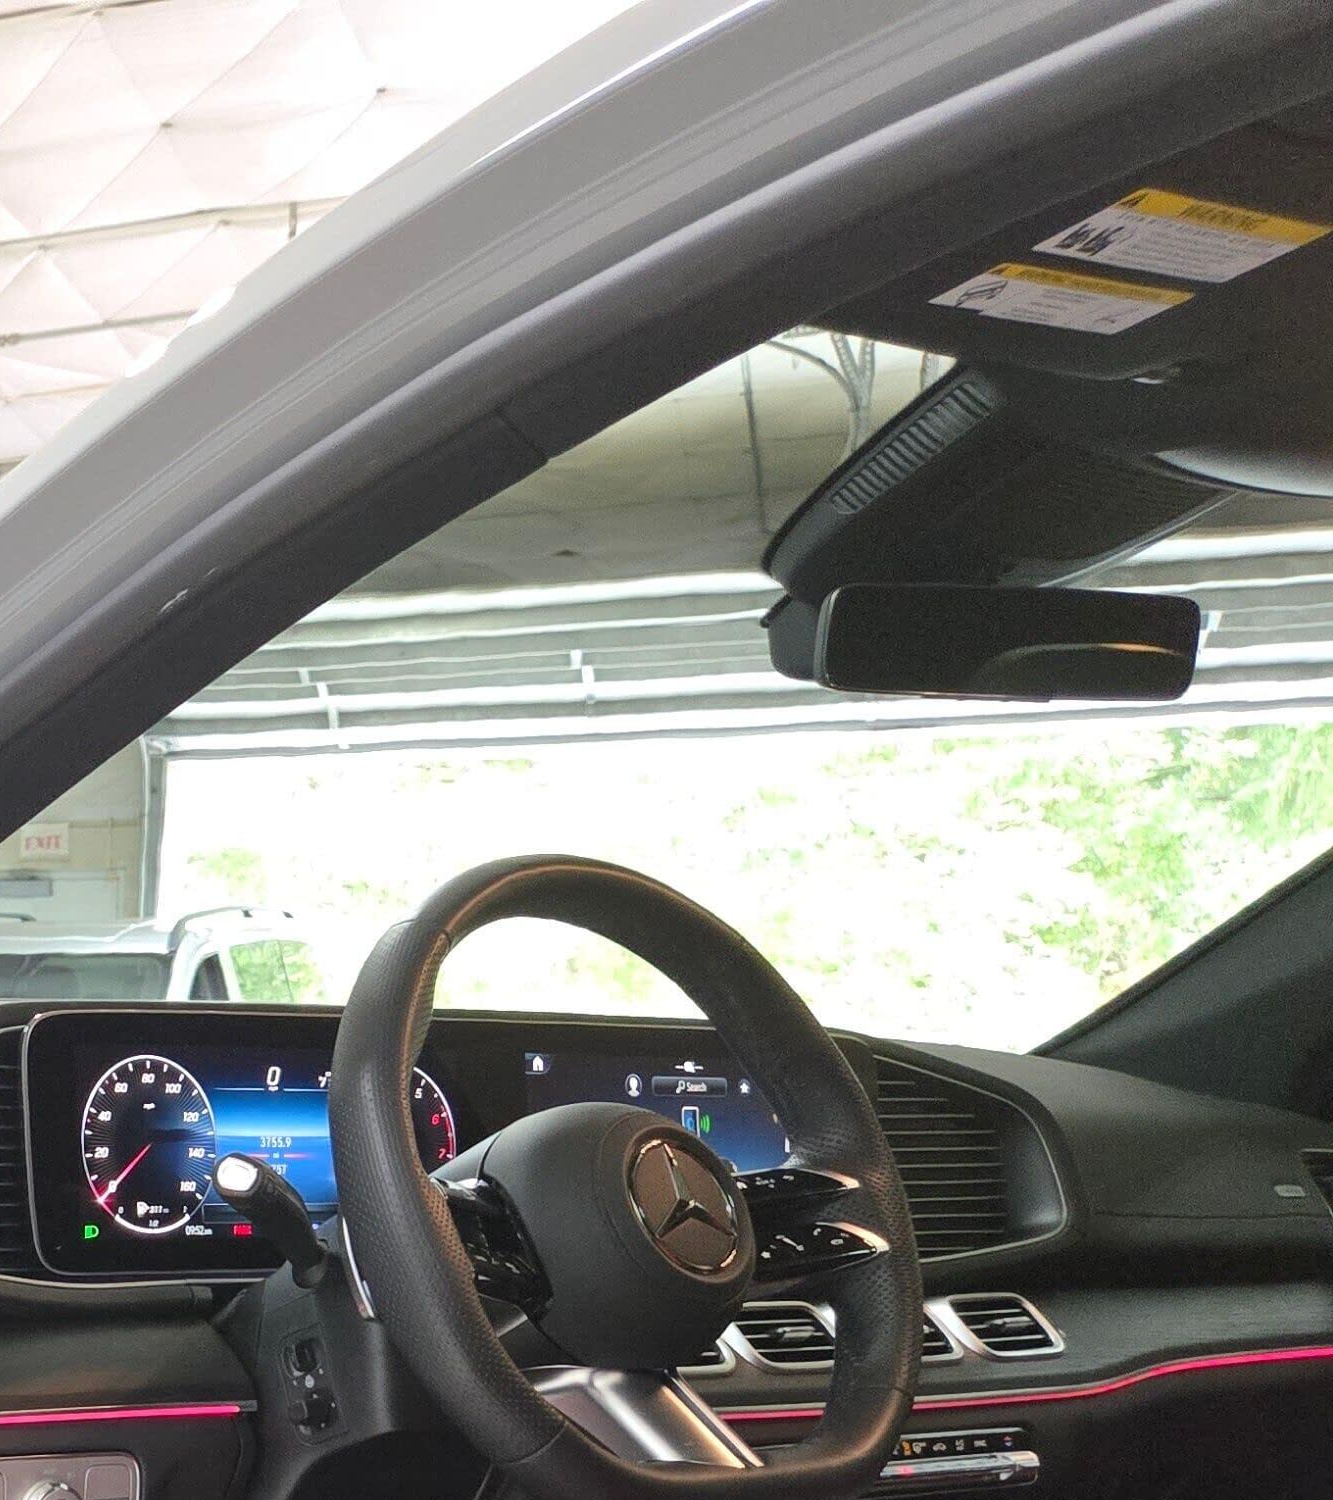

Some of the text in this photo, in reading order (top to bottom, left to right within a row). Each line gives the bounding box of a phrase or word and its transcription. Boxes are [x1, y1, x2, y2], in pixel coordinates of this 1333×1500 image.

[25, 835, 62, 851] EXIT
[142, 1073, 155, 1084] 80
[266, 1066, 282, 1085] 0
[114, 1083, 128, 1093] 60
[165, 1083, 182, 1094] 100
[686, 1082, 708, 1092] Search
[415, 1088, 422, 1098] 5
[98, 1111, 112, 1122] 40
[183, 1112, 199, 1122] 120
[432, 1114, 440, 1125] 6
[260, 1136, 292, 1148] 3755.9
[94, 1147, 109, 1158] 20
[188, 1147, 205, 1158] 140
[438, 1149, 446, 1159] 7
[180, 1182, 196, 1192] 160
